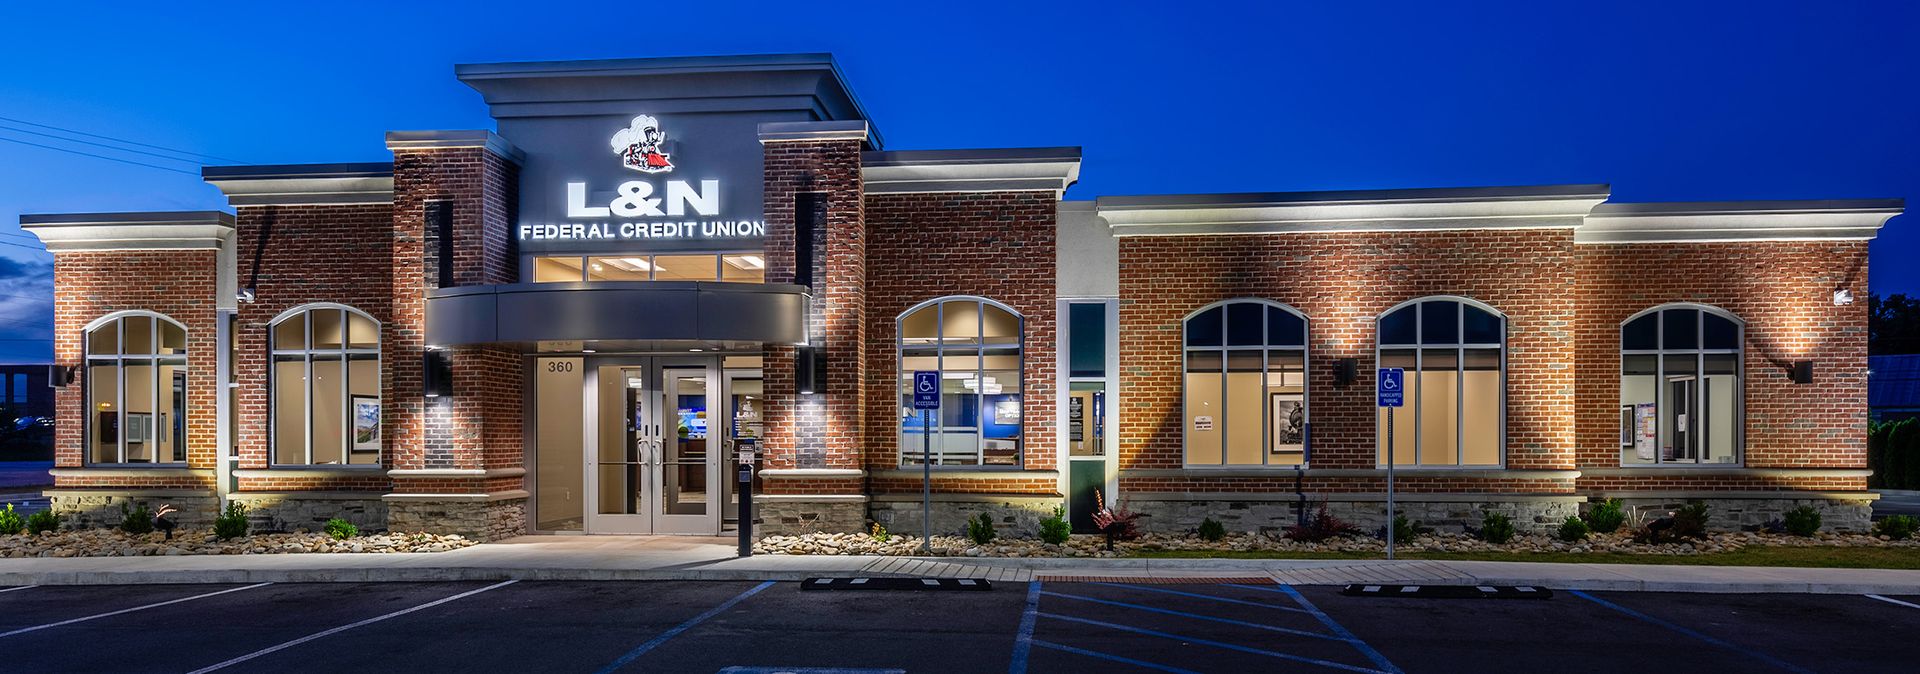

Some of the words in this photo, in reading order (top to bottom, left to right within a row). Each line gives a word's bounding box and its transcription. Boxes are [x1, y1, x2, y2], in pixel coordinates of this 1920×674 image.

[567, 179, 720, 218] L&N
[520, 224, 615, 240] FEDERAL
[620, 222, 697, 238] CREDIT
[702, 220, 764, 237] UNION
[548, 361, 573, 372] 360
